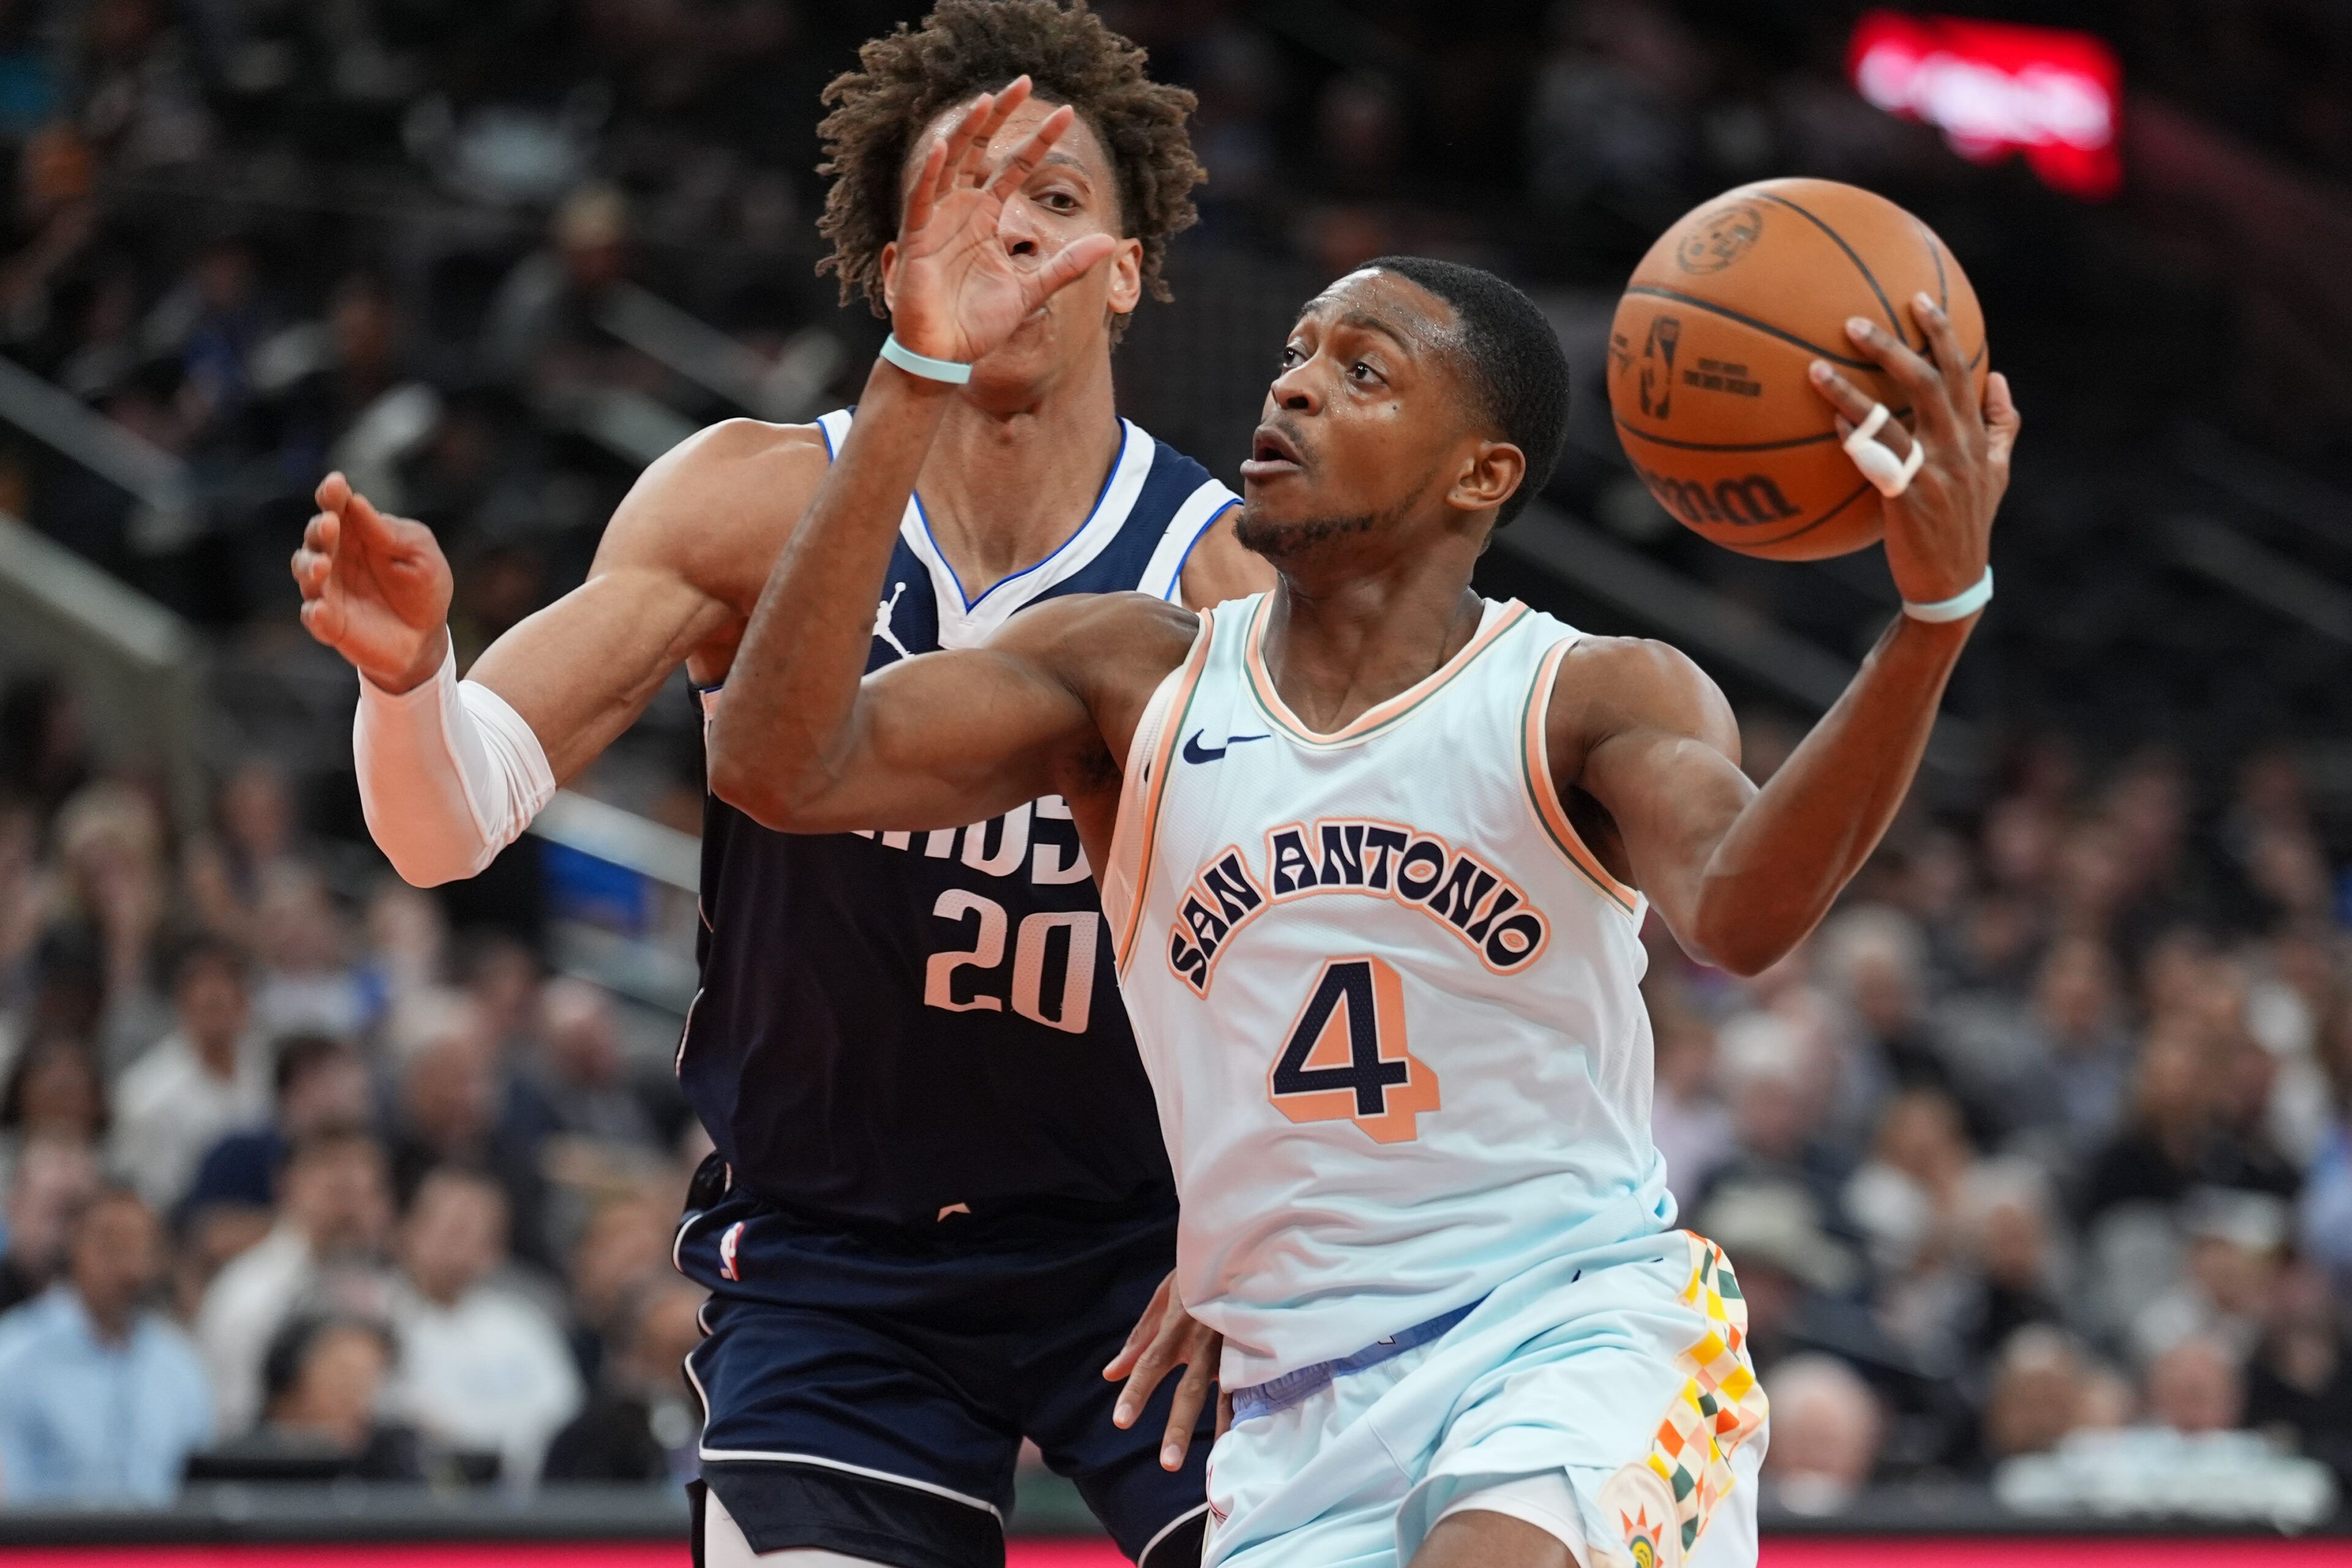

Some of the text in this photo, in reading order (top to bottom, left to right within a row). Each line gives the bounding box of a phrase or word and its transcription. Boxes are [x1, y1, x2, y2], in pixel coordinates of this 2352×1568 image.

[924, 888, 1099, 1034] 20
[1168, 820, 1550, 998] SAN ANTONIO
[1269, 957, 1412, 1118] 4
